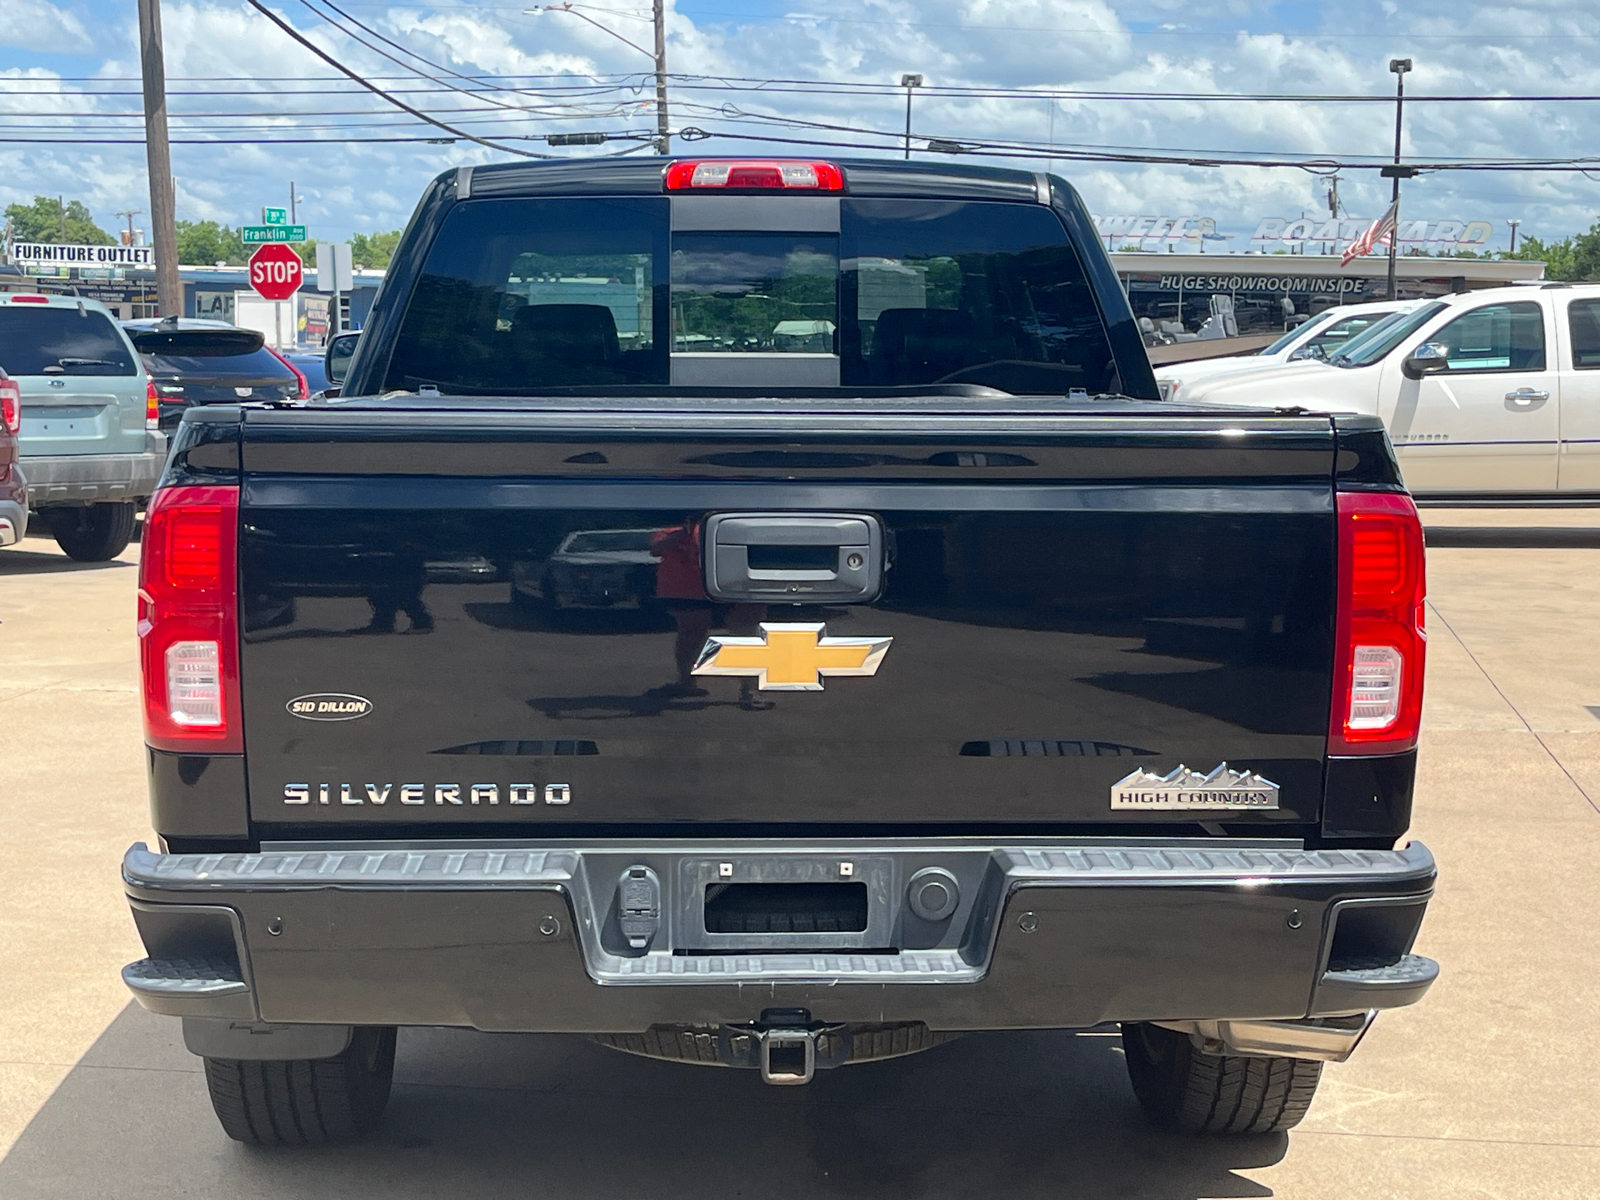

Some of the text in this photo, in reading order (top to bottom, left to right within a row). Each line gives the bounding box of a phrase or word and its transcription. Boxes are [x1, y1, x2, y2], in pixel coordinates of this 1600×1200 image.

[244, 228, 286, 240] Franklin
[15, 245, 150, 263] FURNITURE OUTLET
[253, 261, 299, 284] STOP
[1159, 275, 1365, 293] HUGE SHOWROOM INSIDE
[292, 701, 367, 713] SID DILLON
[283, 783, 571, 805] SILVERADO
[1119, 792, 1274, 805] HIGH COUNTRY
